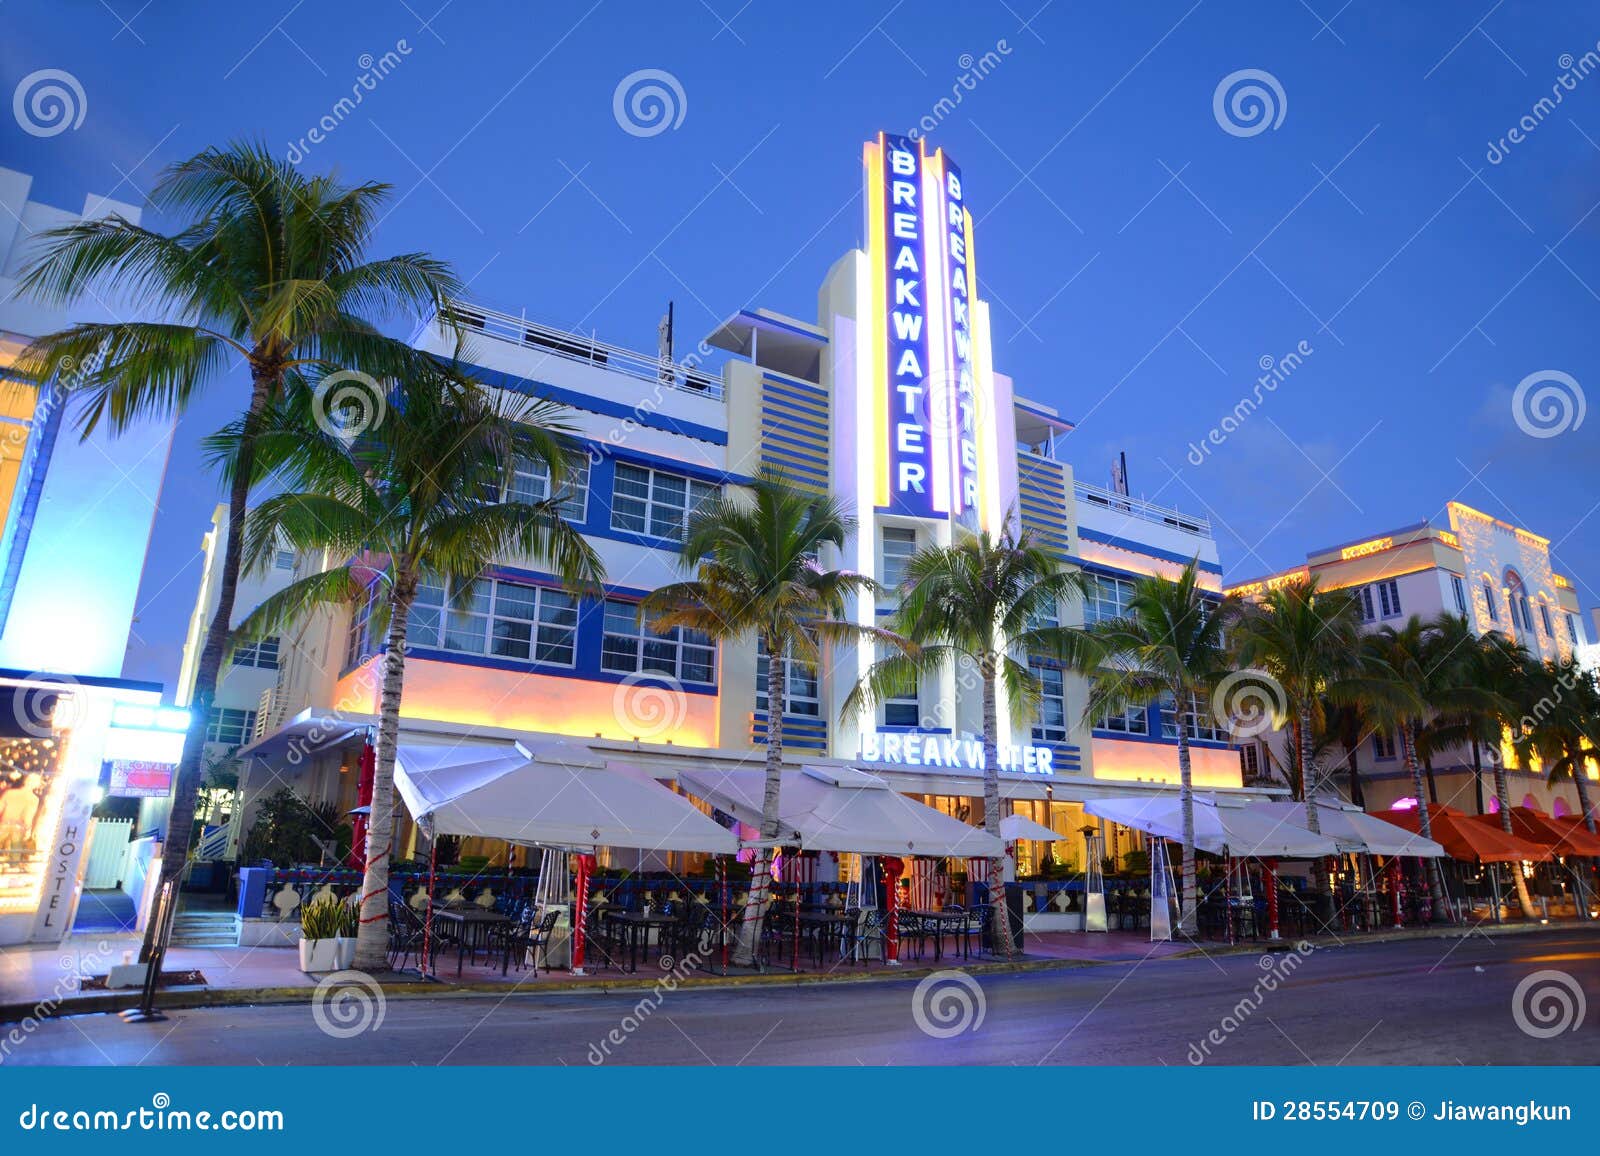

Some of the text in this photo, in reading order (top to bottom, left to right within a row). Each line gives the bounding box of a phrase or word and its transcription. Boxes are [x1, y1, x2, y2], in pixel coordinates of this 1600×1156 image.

[892, 150, 926, 493] BREAKWATER
[947, 171, 978, 507] BREAKWATER
[44, 825, 77, 928] HOSTEL
